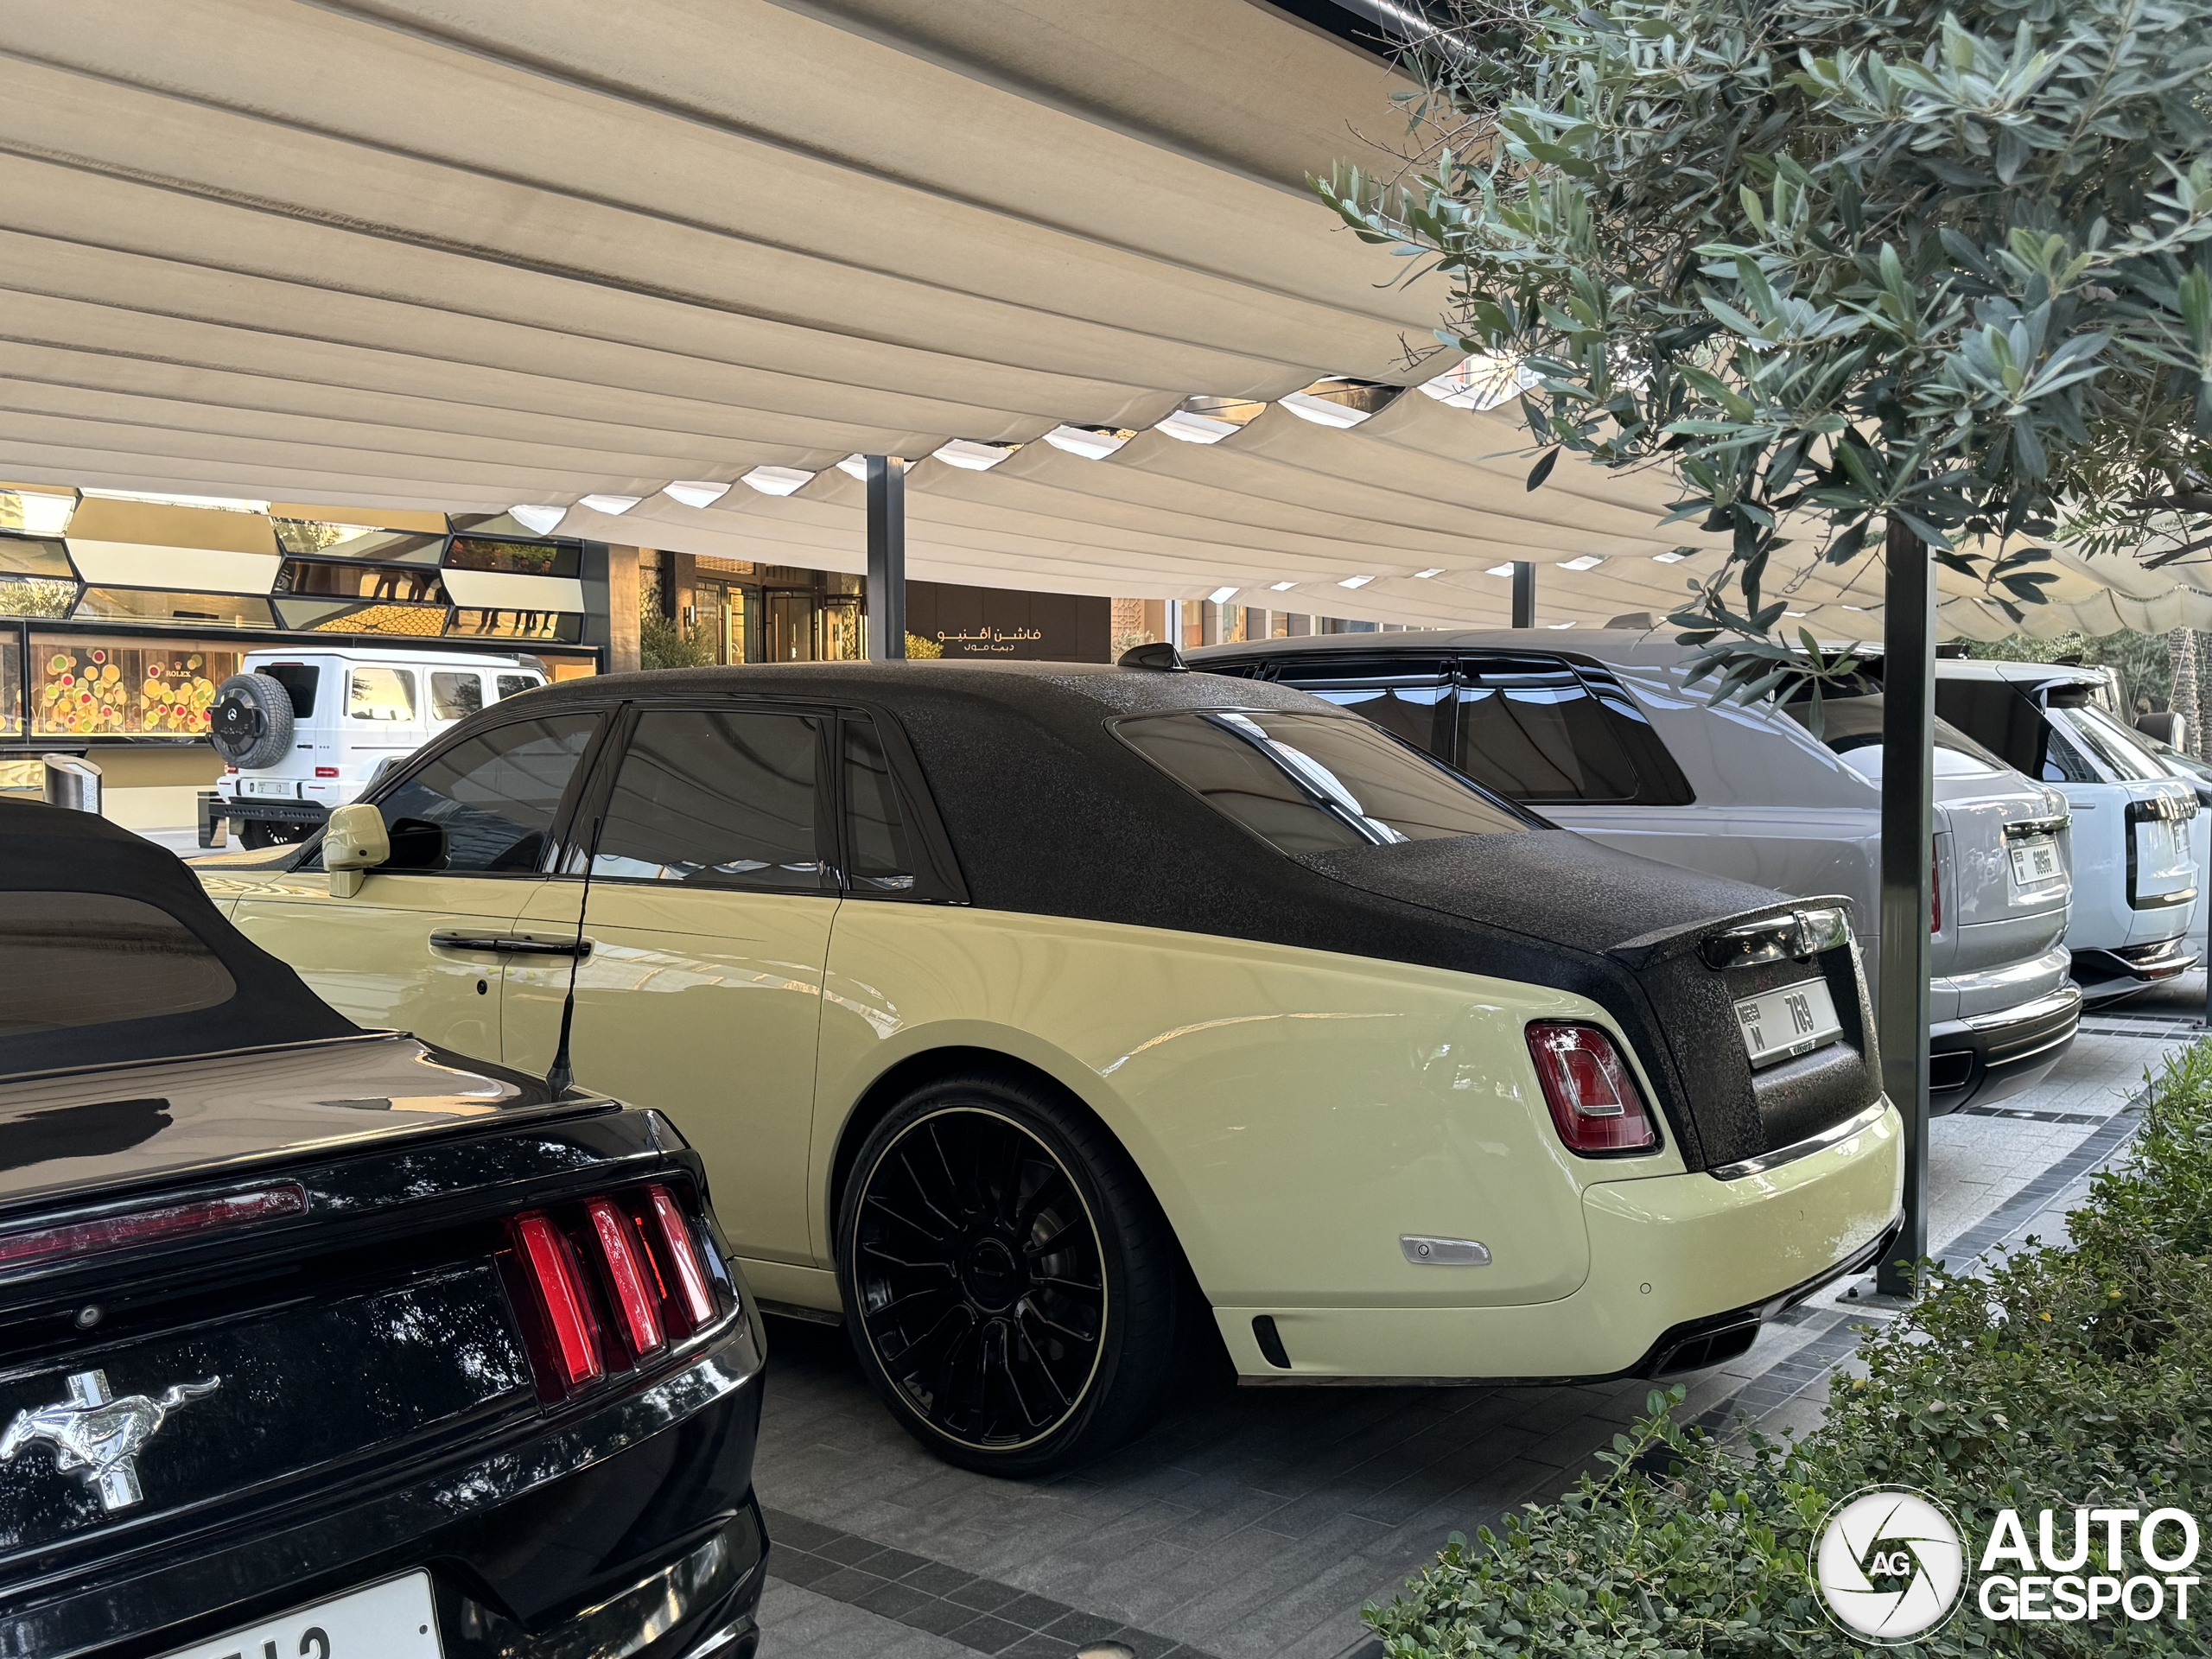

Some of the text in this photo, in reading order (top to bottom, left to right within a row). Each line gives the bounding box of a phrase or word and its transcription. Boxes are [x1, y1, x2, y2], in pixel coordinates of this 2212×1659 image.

[994, 626, 1041, 642] فاشن
[963, 643, 1014, 652] دبي مول
[166, 670, 192, 678] ROLEX
[1784, 991, 1814, 1034] 769
[1750, 1024, 1765, 1052] M
